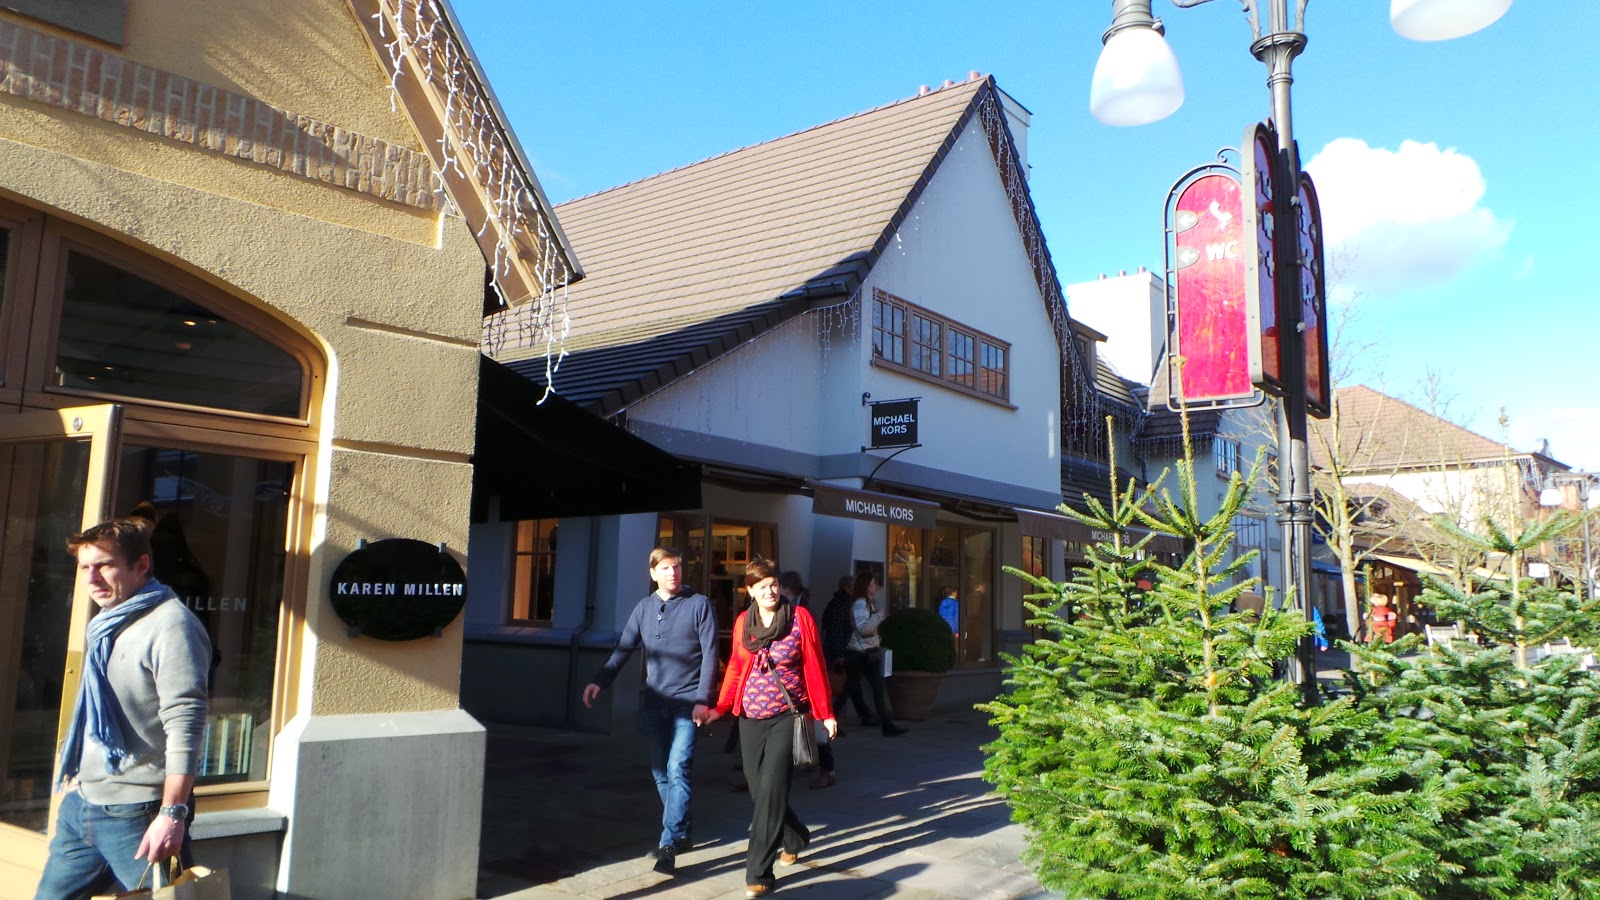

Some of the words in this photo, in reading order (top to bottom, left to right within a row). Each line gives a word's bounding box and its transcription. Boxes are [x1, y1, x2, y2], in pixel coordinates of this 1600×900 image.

[1205, 240, 1239, 261] WC
[873, 413, 915, 426] MICHAEL
[881, 424, 907, 435] KORS
[845, 499, 887, 517] MICHAEL
[890, 506, 914, 521] KORS
[337, 582, 396, 596] KAREN
[403, 583, 463, 597] MILLEN
[185, 596, 248, 612] ILLEN
